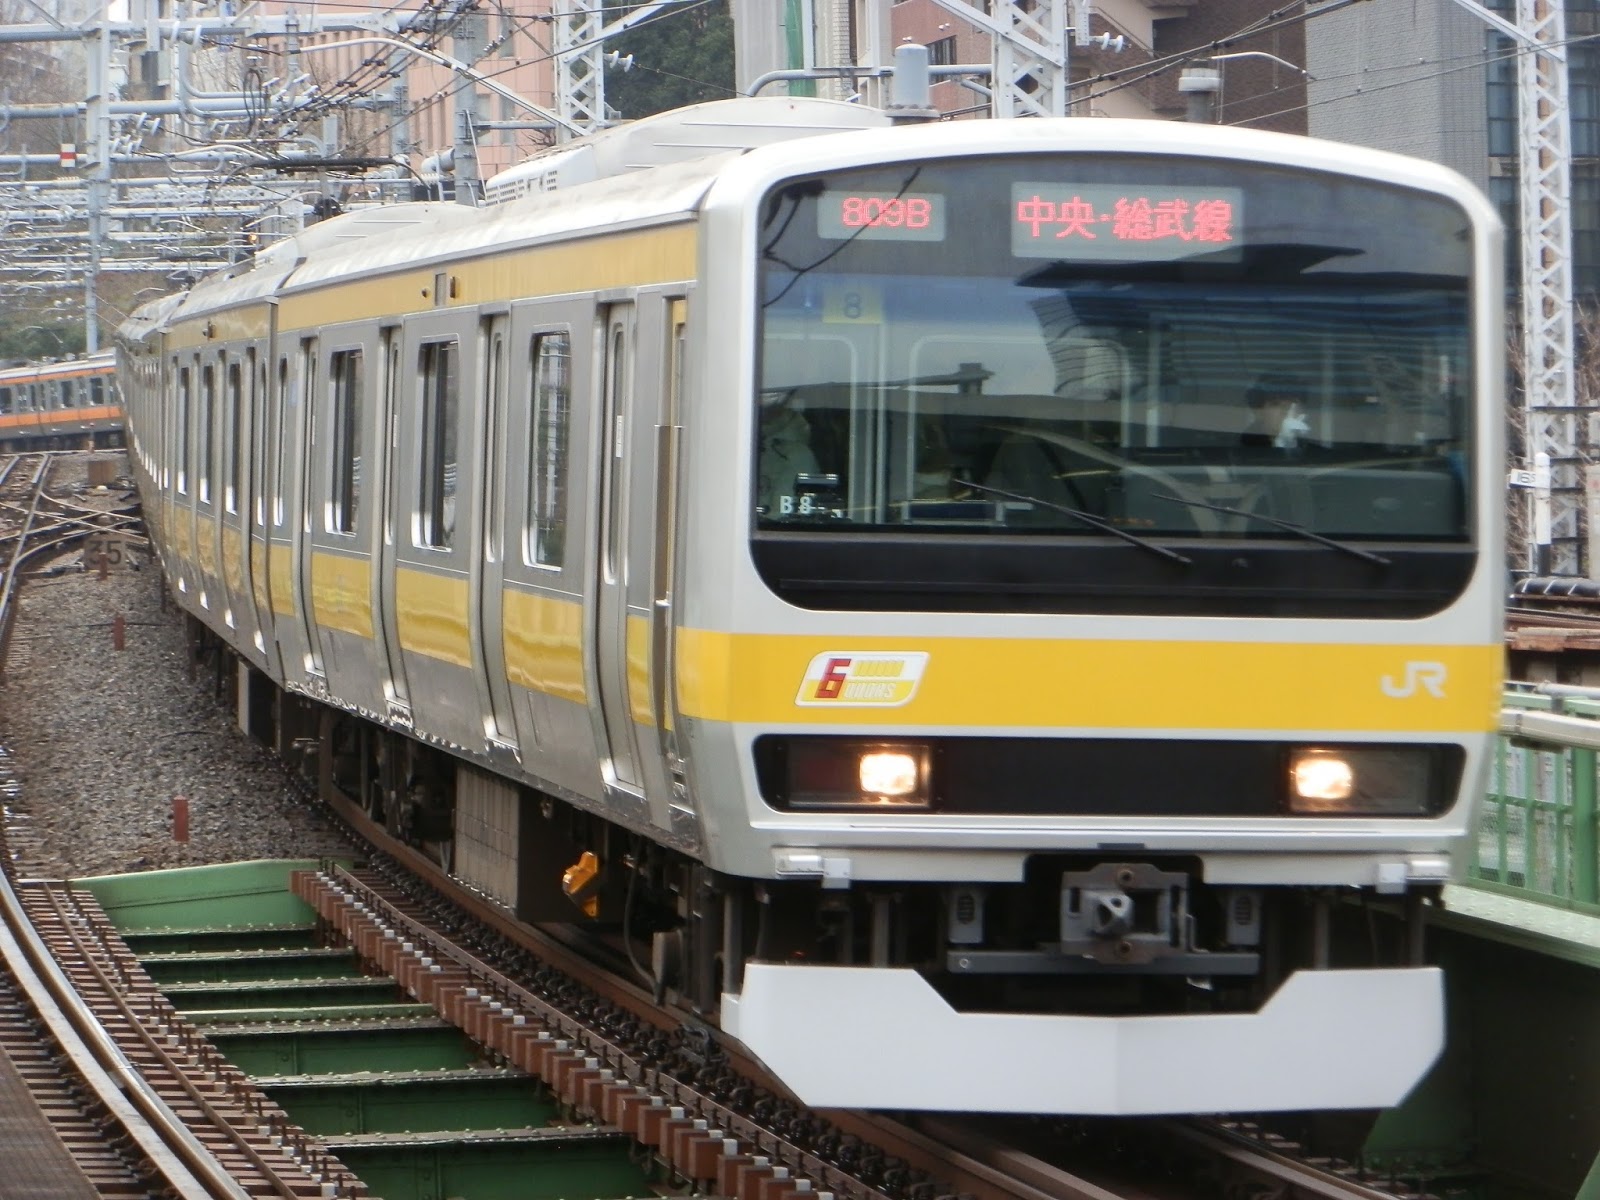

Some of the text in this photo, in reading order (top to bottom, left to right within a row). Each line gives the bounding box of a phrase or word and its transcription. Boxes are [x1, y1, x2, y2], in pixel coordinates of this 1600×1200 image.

[842, 196, 931, 230] 809B
[814, 658, 852, 698] 6
[1380, 661, 1447, 698] JR
